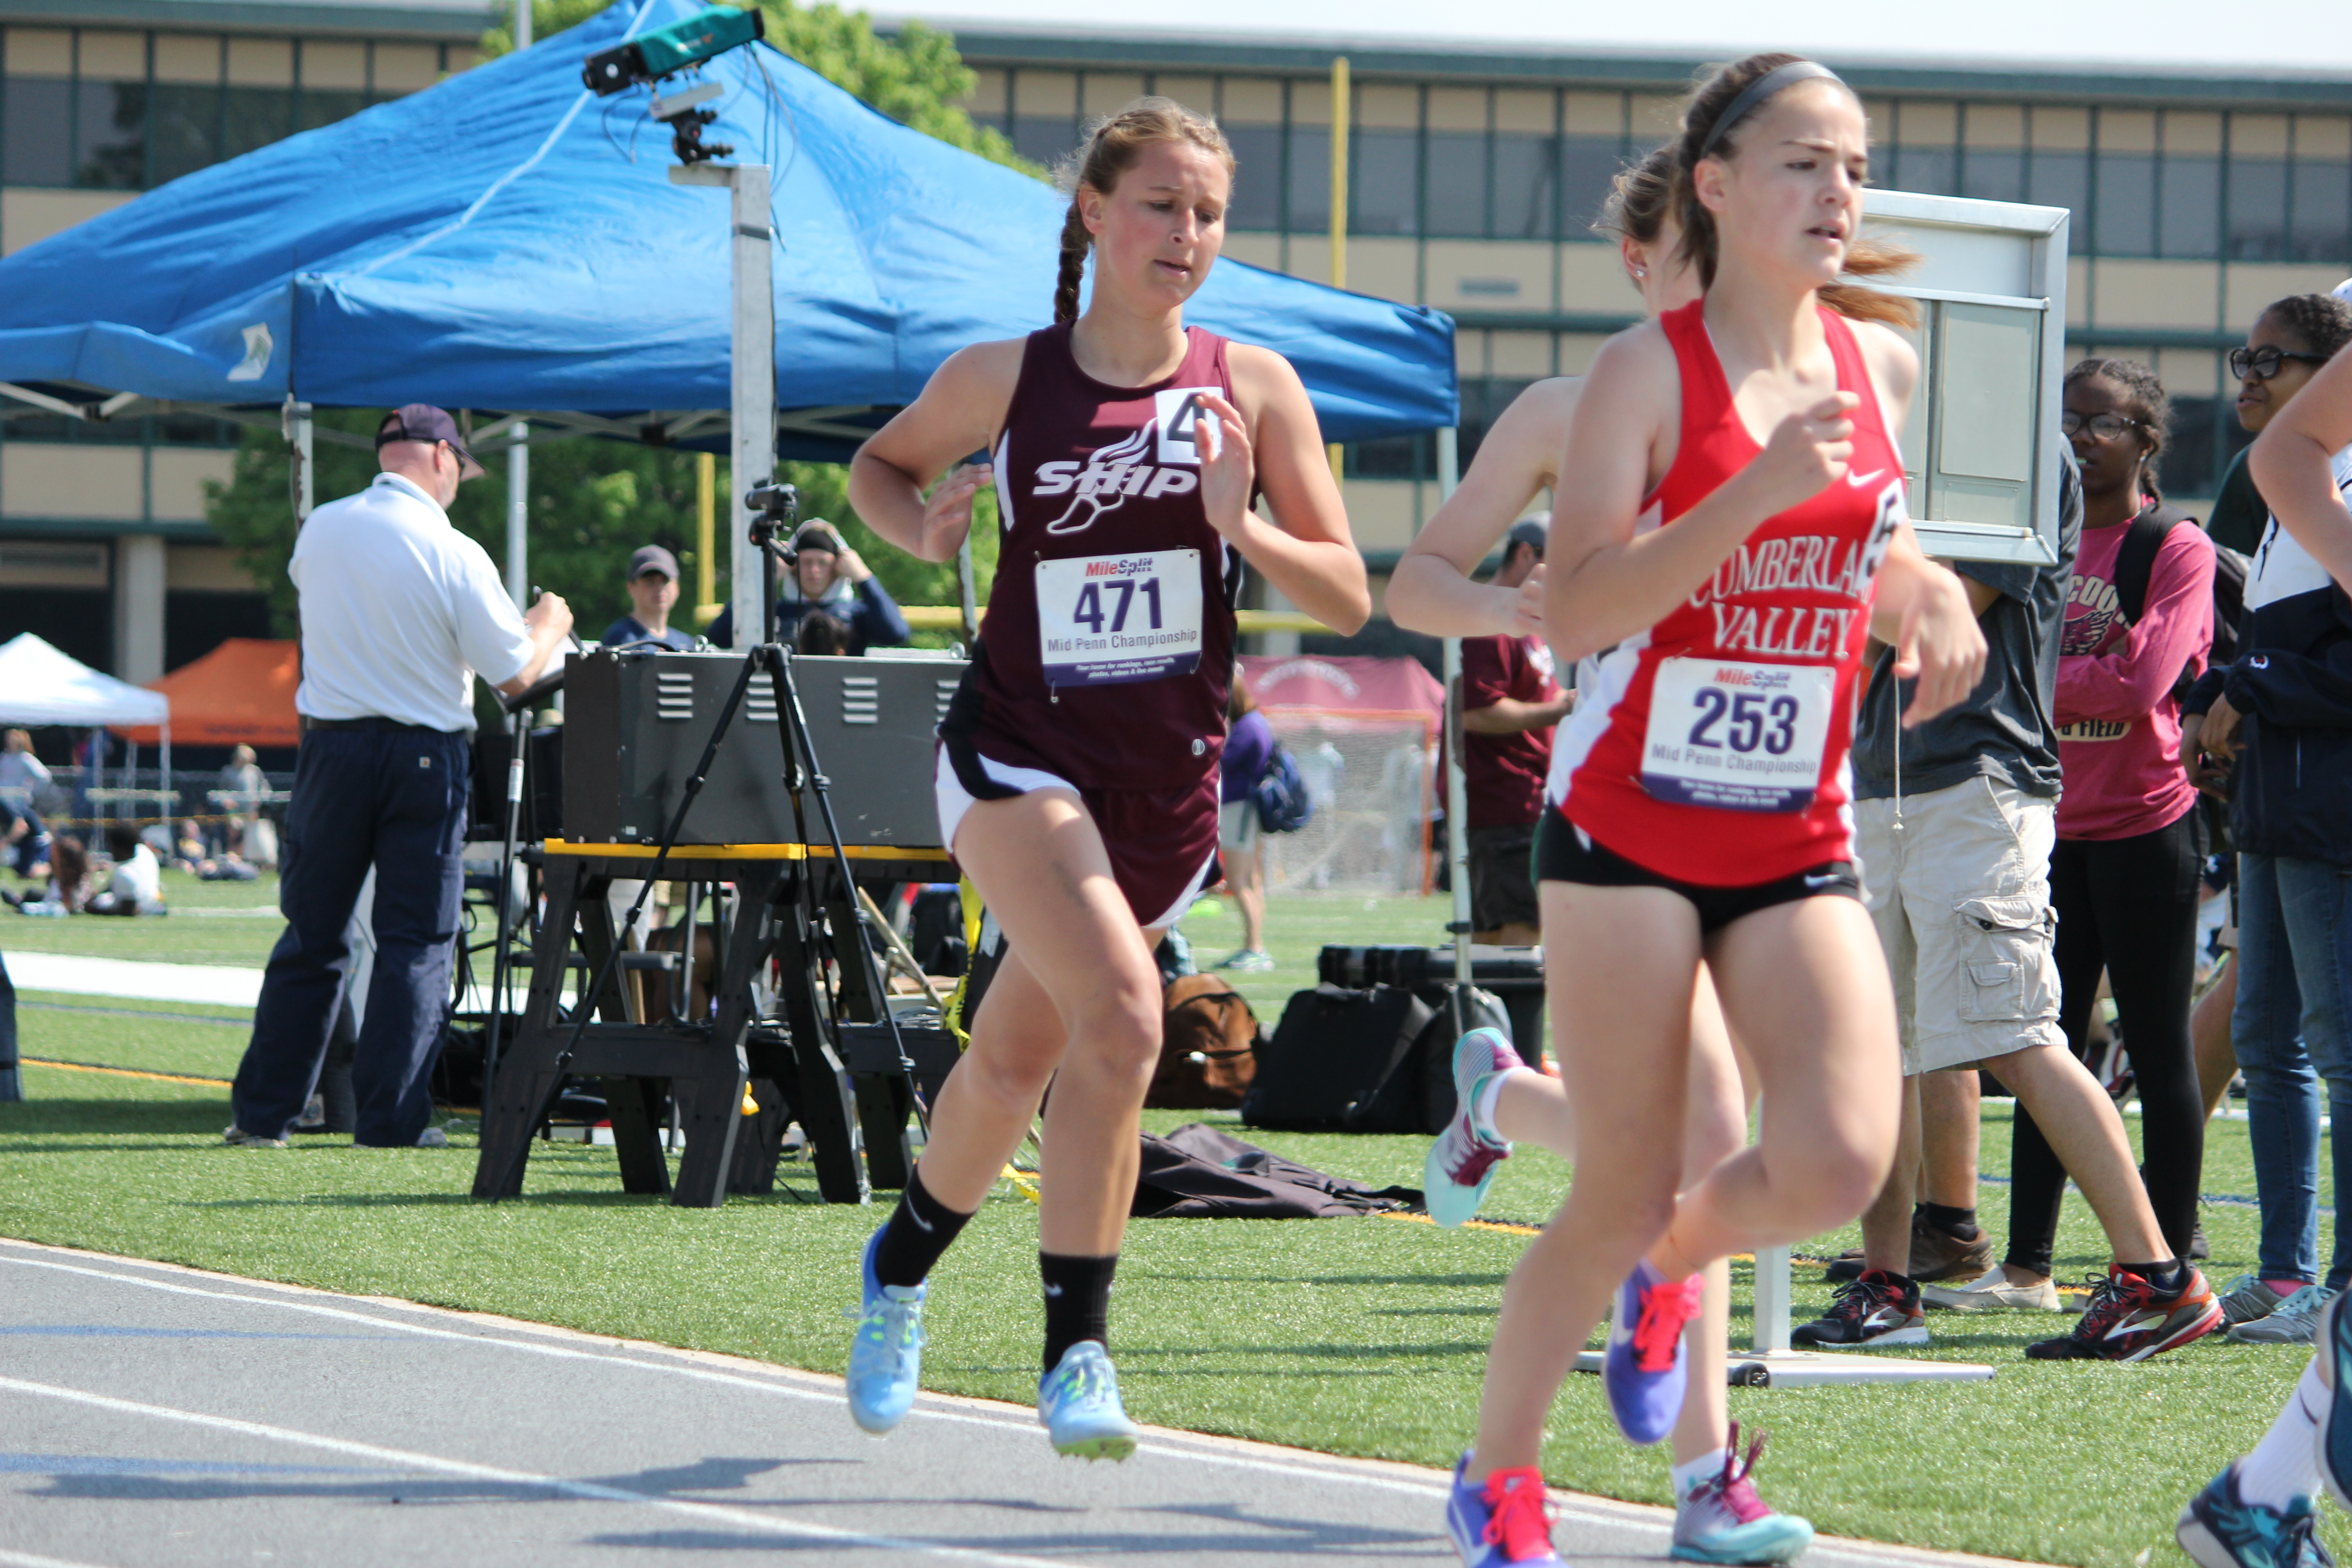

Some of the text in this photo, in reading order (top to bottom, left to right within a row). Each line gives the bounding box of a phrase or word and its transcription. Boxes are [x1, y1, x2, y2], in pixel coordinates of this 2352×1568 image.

[1166, 392, 1214, 458] 4
[1032, 461, 1197, 498] SHIP
[1085, 557, 1153, 577] MileSplit
[1689, 535, 1870, 608] UMBERLA
[1073, 577, 1162, 633] 471
[1048, 629, 1197, 652] Mid Penn Championship
[1711, 601, 1859, 660] VALLEY
[1714, 667, 1791, 691] MileSplit
[1688, 686, 1799, 755] 253
[1652, 743, 1817, 775] Mid Penn Championship
